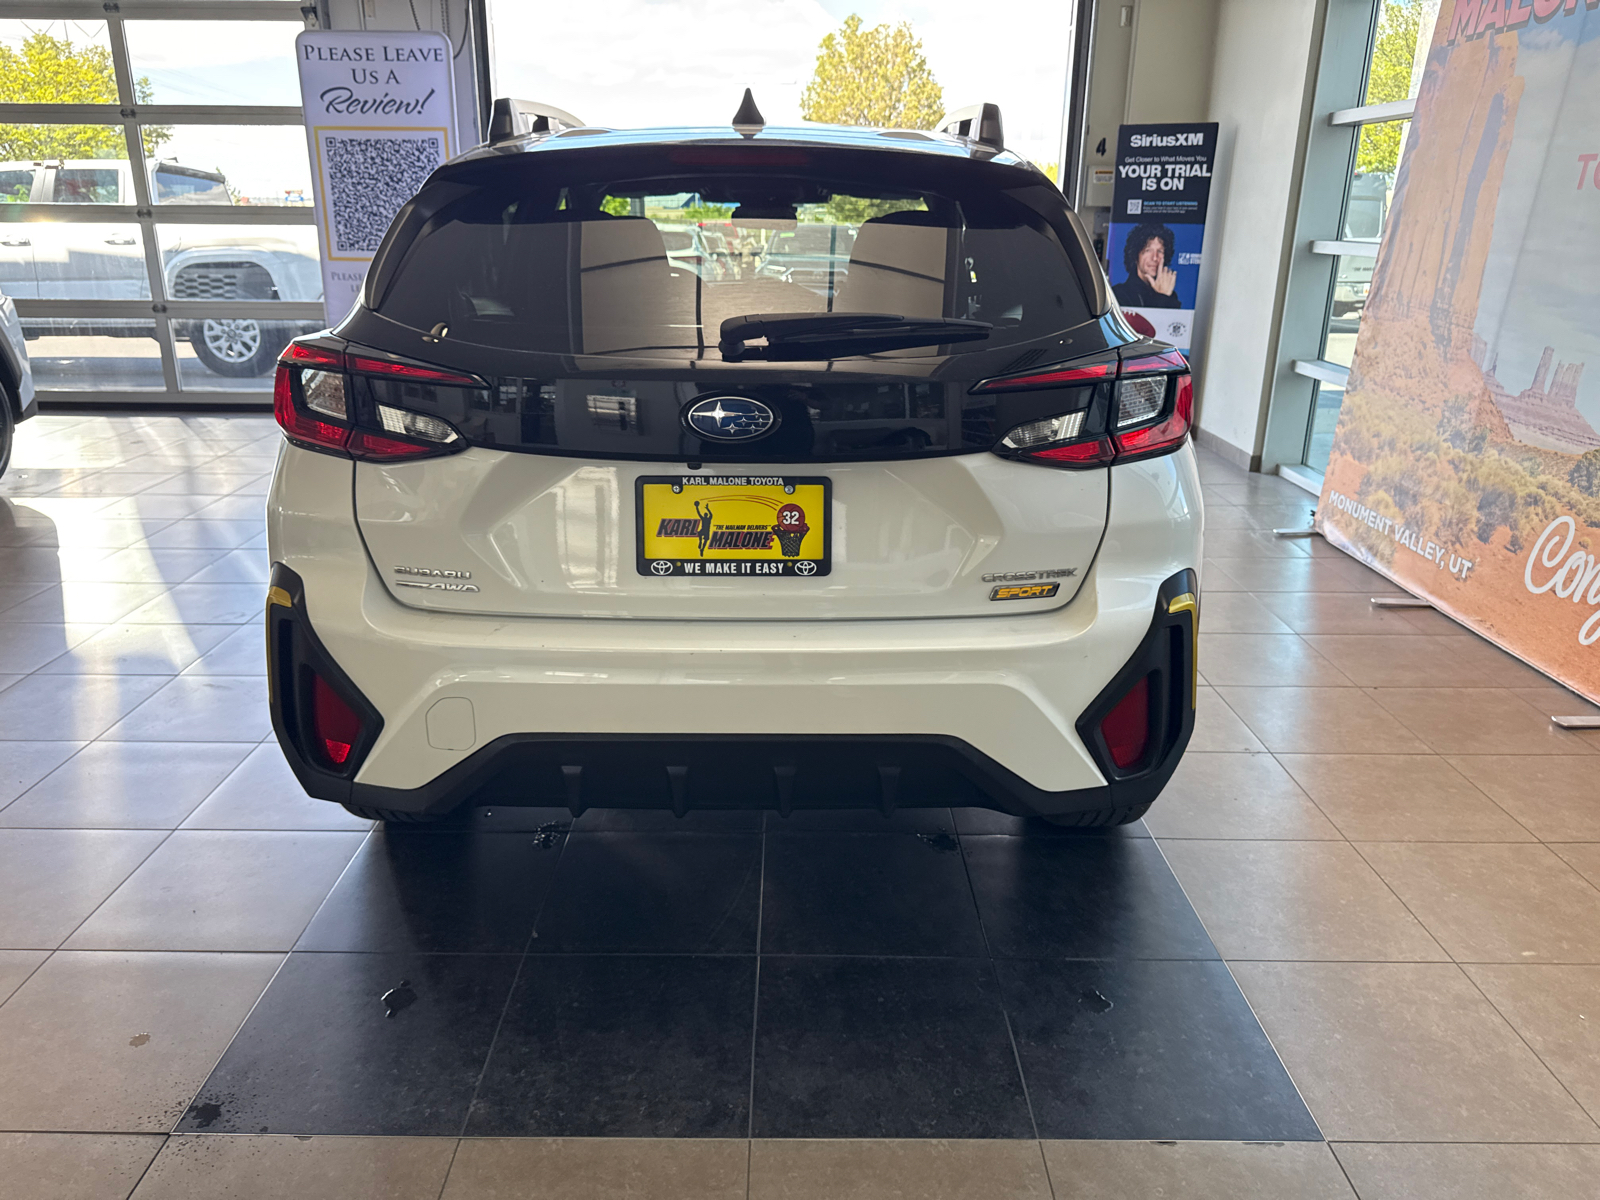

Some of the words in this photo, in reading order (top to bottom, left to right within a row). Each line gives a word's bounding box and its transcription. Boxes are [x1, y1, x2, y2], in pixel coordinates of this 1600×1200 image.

[304, 45, 376, 62] PLEASE
[382, 46, 444, 62] LEAVE
[351, 68, 379, 85] US
[385, 69, 400, 85] A
[319, 86, 436, 115] Review!
[1095, 137, 1106, 157] 4
[1130, 133, 1204, 148] SiriusXM
[1119, 164, 1161, 178] YOUR
[1164, 164, 1211, 177] TRIAL
[1142, 178, 1157, 191] IS
[1160, 178, 1184, 191] ON
[682, 477, 707, 486] KARL
[709, 477, 748, 486] MALONE
[749, 477, 784, 486] TOYOTA
[782, 510, 800, 525] 32
[656, 518, 701, 537] KARL
[1329, 490, 1393, 535] MONUMENT
[1394, 524, 1446, 570] VALLEY,
[1448, 553, 1473, 579] UT
[707, 530, 774, 549] MALONE
[394, 566, 471, 579] SUBARU
[684, 562, 702, 574] WE
[705, 562, 737, 574] MAKE
[741, 562, 754, 574] IT
[757, 562, 784, 574] EASY
[982, 568, 1078, 583] CROSSTREK
[428, 582, 480, 592] AWD
[996, 585, 1053, 599] SPORT
